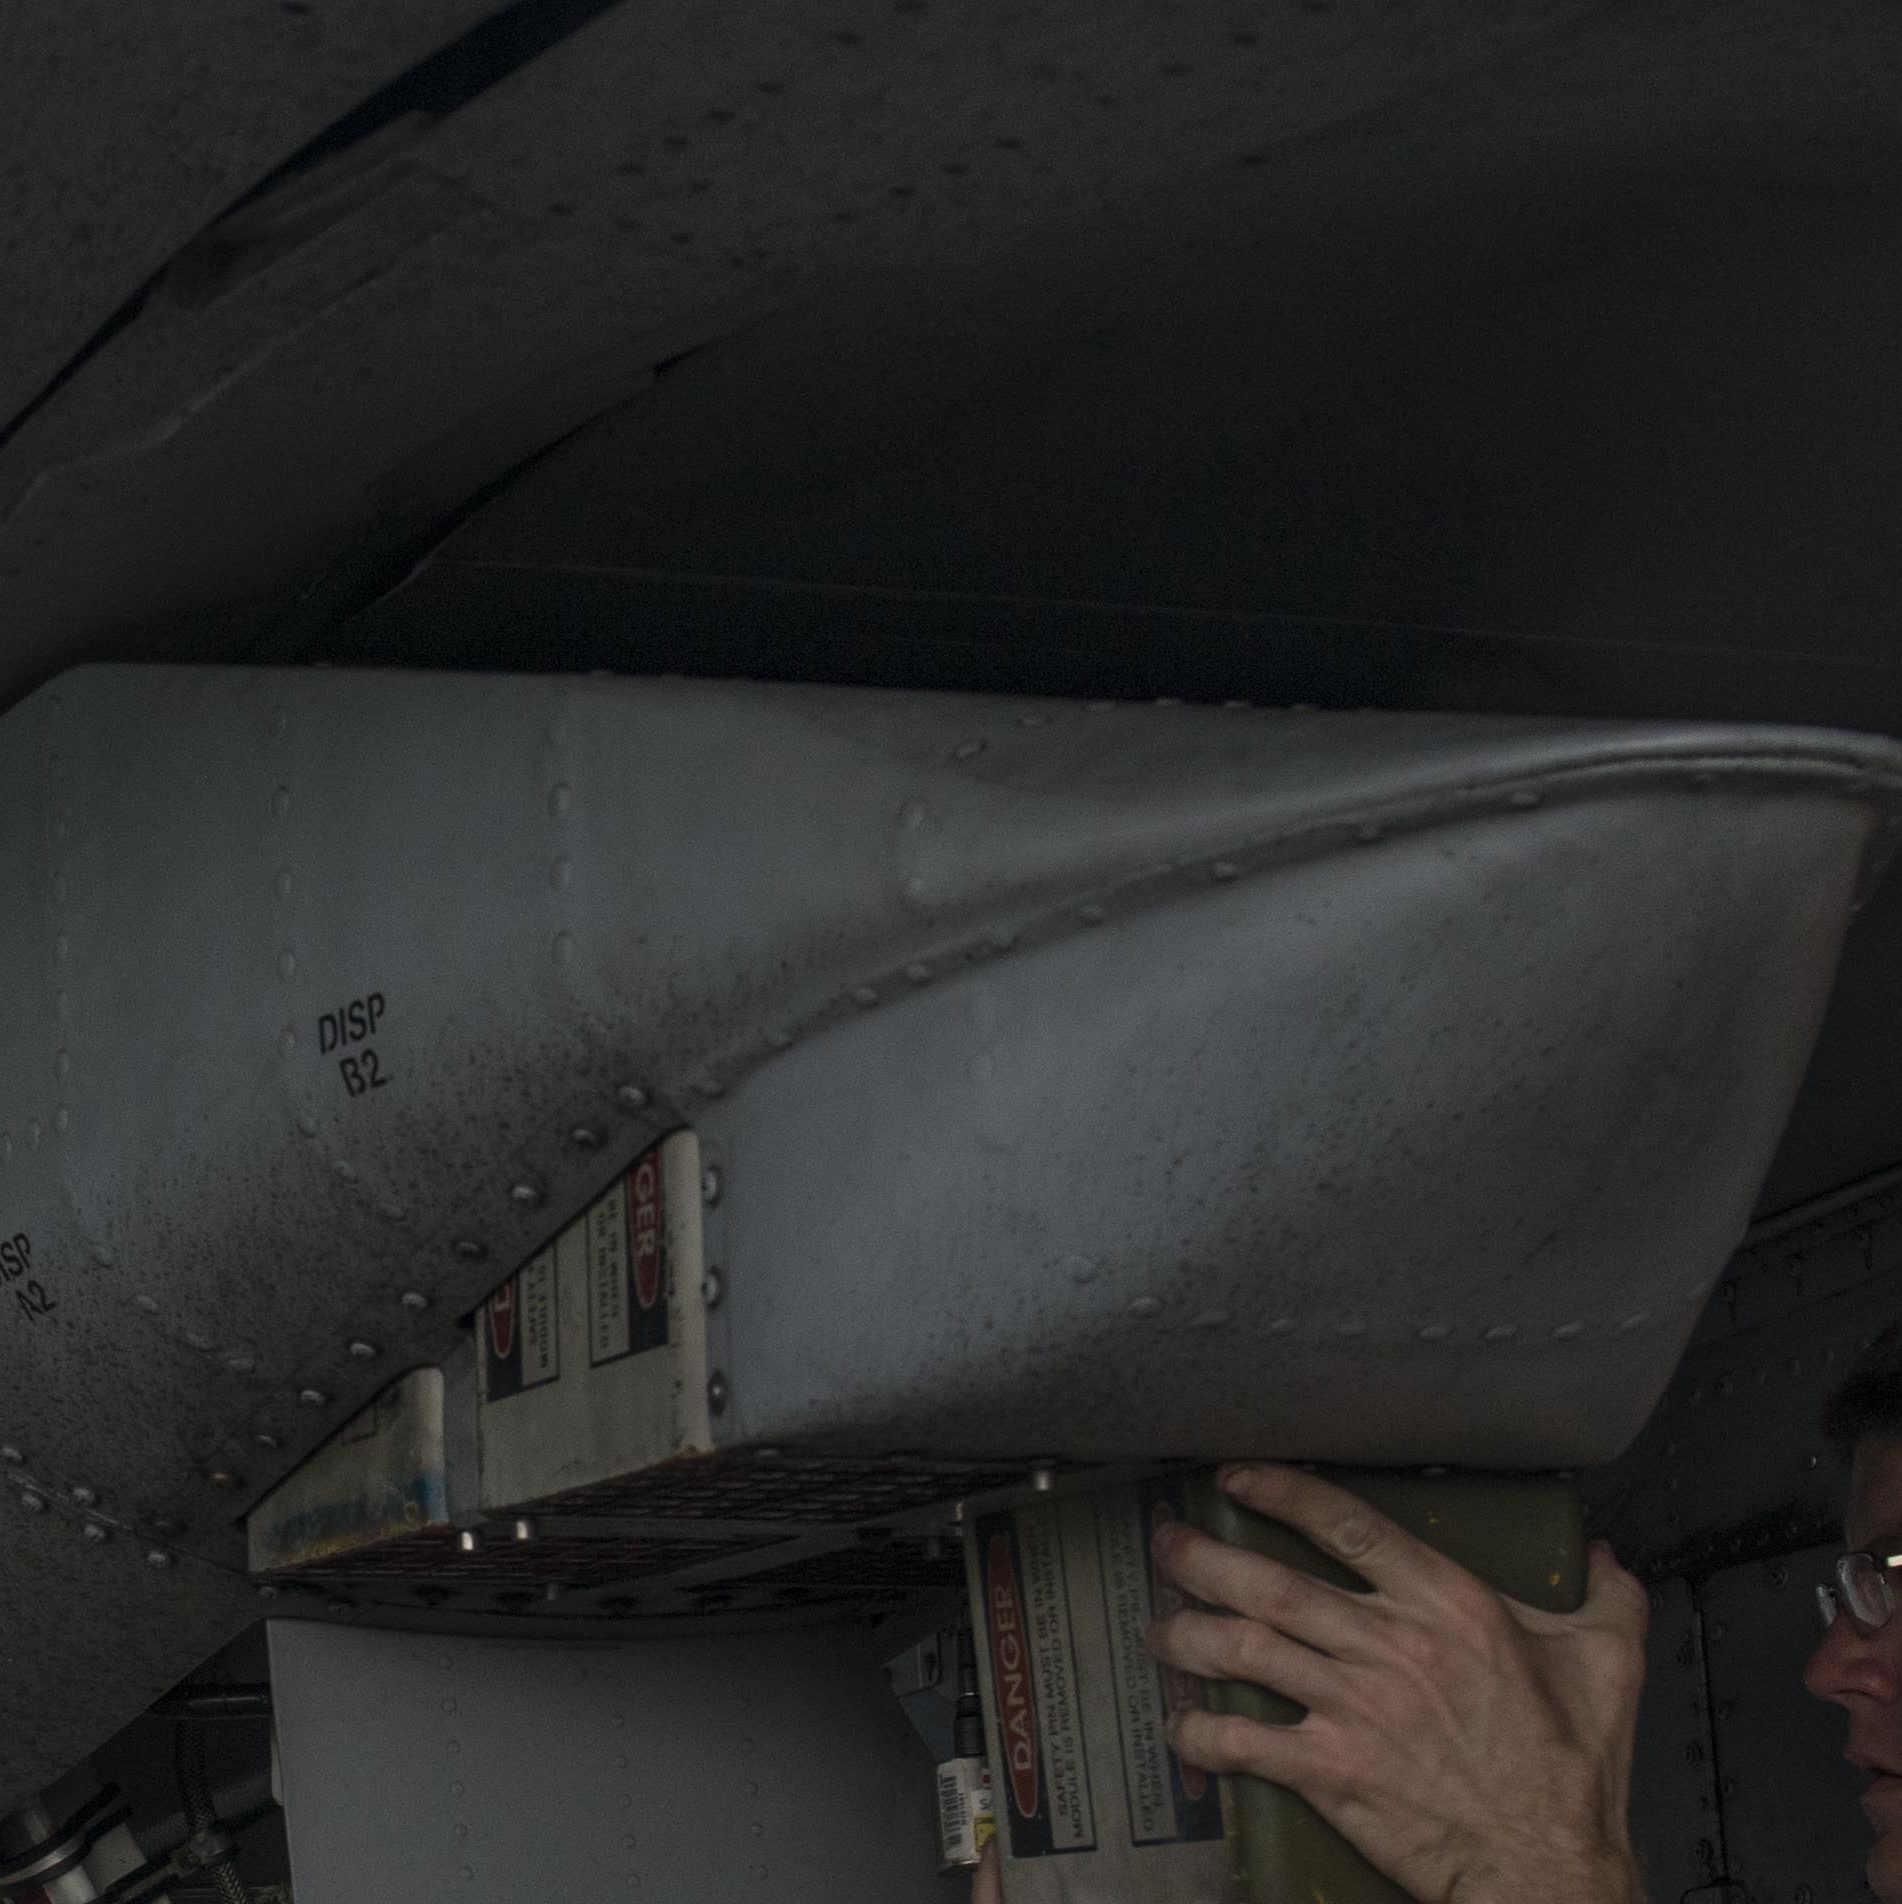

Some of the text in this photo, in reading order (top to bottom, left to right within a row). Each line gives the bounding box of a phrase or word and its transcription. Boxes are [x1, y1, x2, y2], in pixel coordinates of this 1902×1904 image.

[317, 990, 386, 1057] DISP
[339, 1050, 390, 1099] B2
[635, 1160, 656, 1257] GER
[15, 1279, 58, 1323] A2
[1031, 1587, 1045, 1609] IN
[1044, 1604, 1061, 1634] OR
[1033, 1614, 1049, 1640] BE
[1117, 1594, 1138, 1690] REMOVED
[992, 1583, 1035, 1772] DANGER
[1038, 1646, 1057, 1699] MUST
[1051, 1635, 1072, 1732] REMOVED
[1044, 1703, 1061, 1737] PIN
[1128, 1694, 1142, 1724] OR
[1140, 1688, 1152, 1715] BE
[1061, 1735, 1075, 1755] IS
[1143, 1721, 1155, 1741] IN
[1048, 1741, 1069, 1817] SAFETY
[1065, 1758, 1085, 1840] MODULE
[1131, 1727, 1154, 1832] INSTALLED
[1146, 1744, 1164, 1807] WHEN
